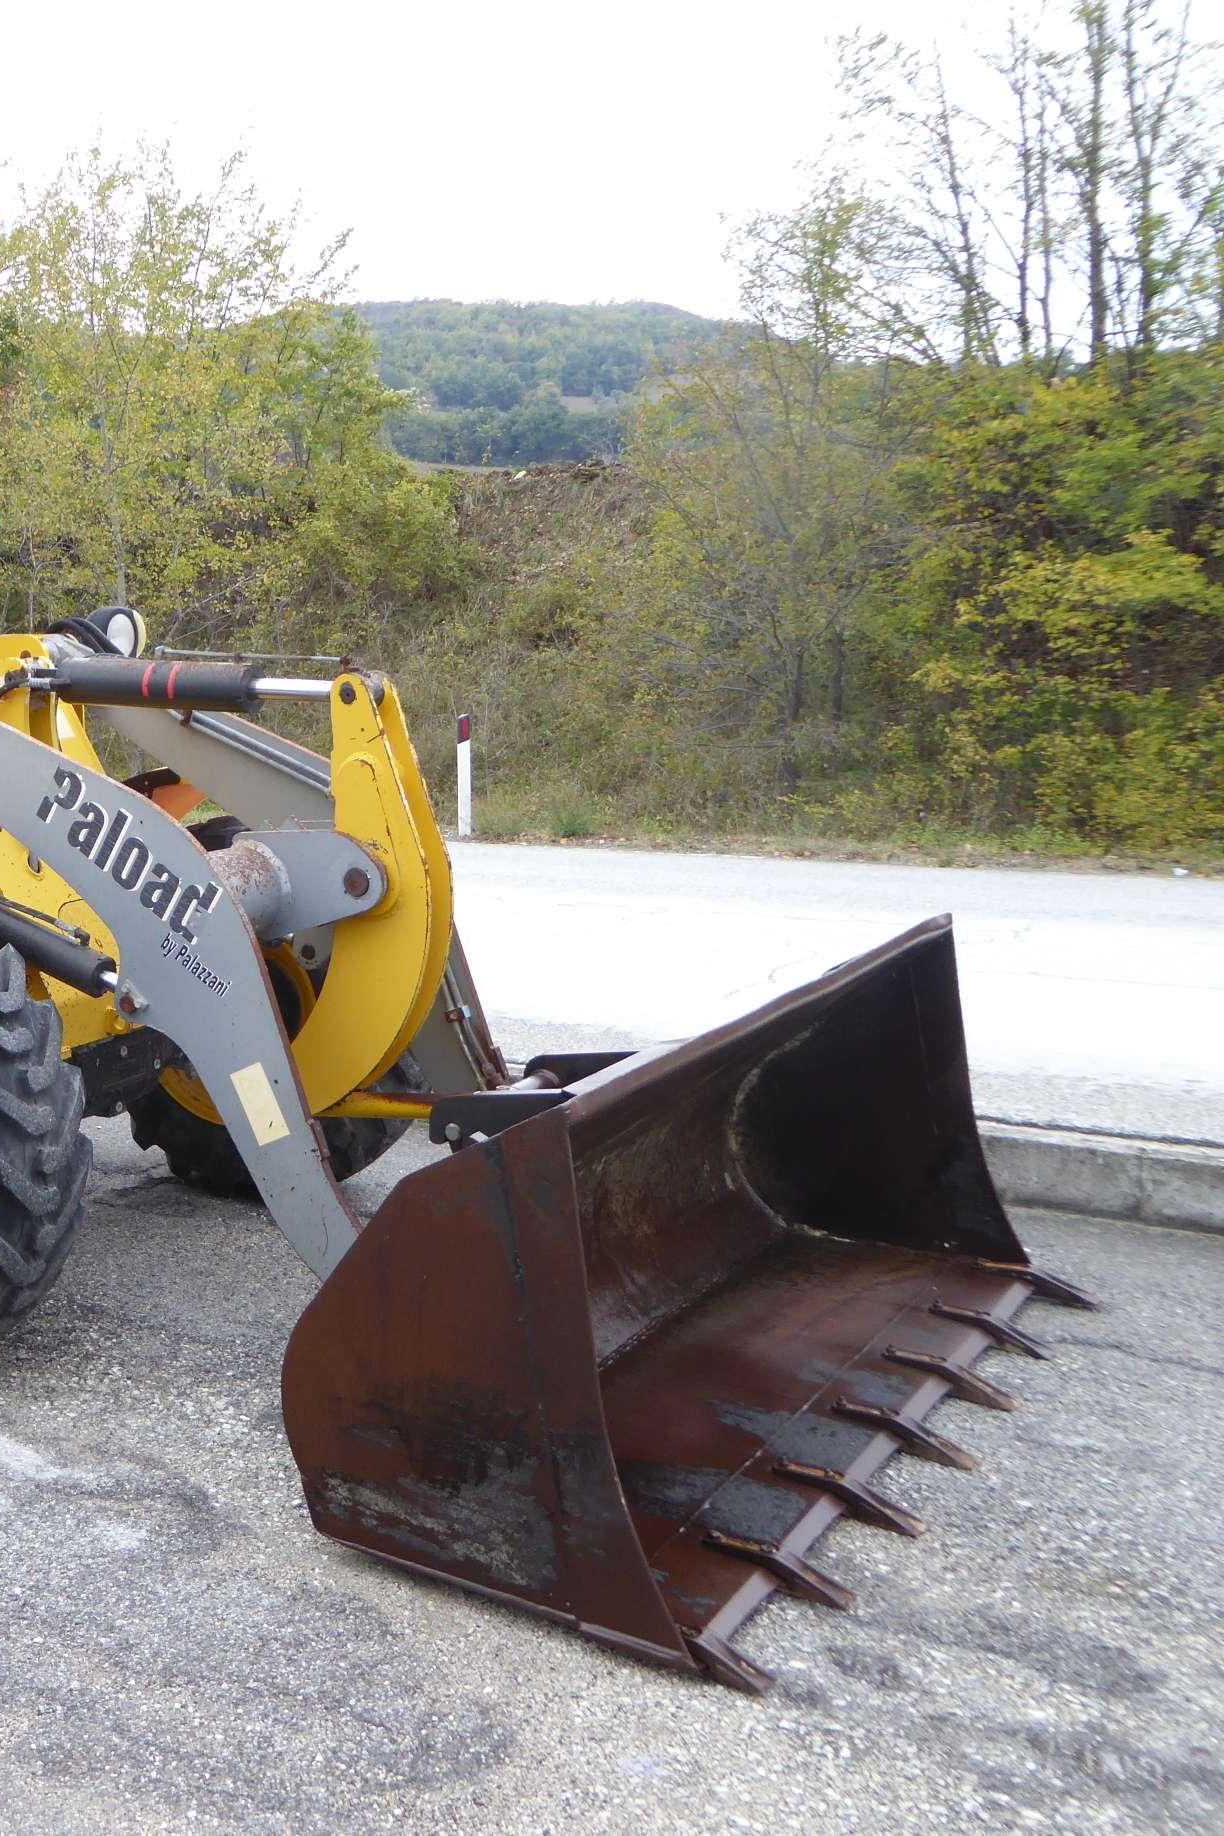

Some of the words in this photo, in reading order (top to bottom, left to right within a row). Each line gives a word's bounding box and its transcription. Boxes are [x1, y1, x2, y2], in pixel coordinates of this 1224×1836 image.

[36, 764, 222, 944] Paload
[161, 932, 177, 957] by
[175, 944, 232, 997] Palazzani
